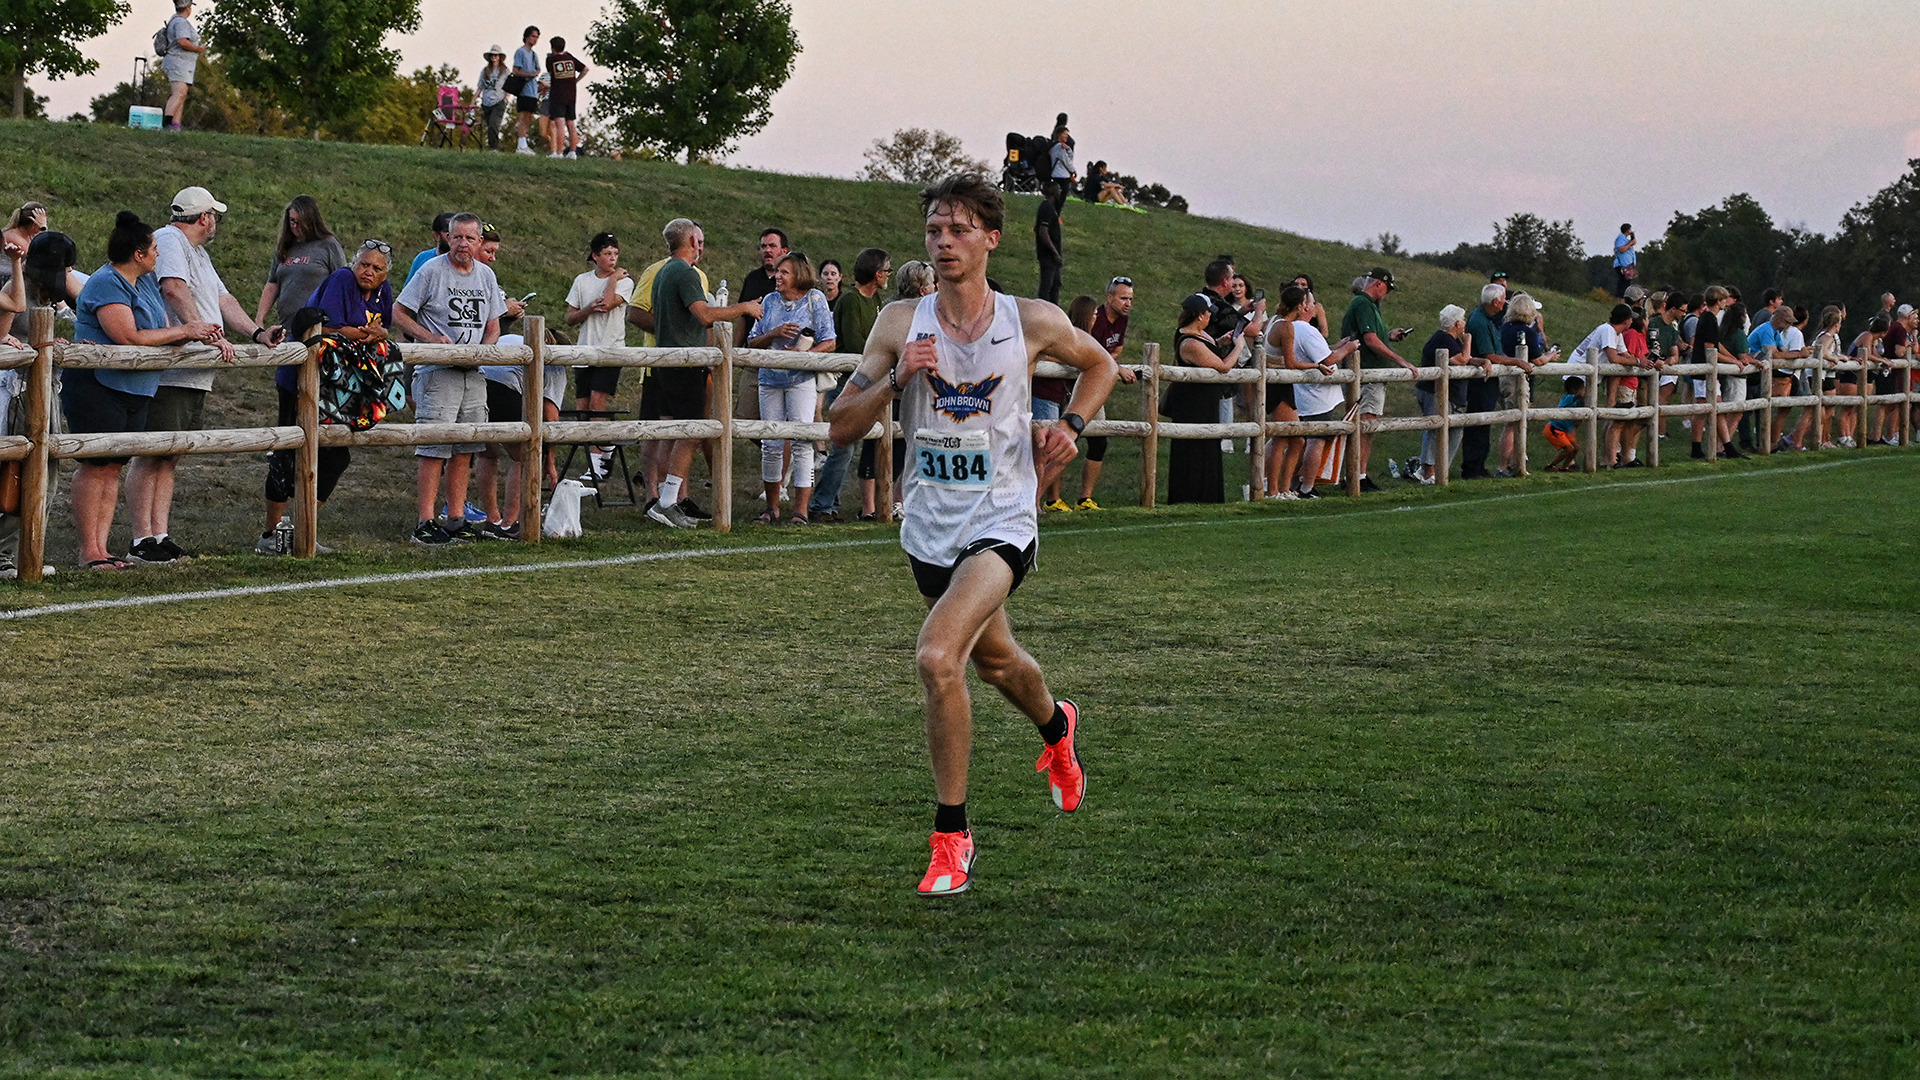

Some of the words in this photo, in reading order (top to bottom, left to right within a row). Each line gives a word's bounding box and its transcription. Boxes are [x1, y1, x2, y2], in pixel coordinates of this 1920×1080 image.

[448, 297, 486, 322] S&T
[935, 396, 957, 409] JOHN
[957, 396, 990, 411] BROWN
[921, 451, 988, 481] 3184
